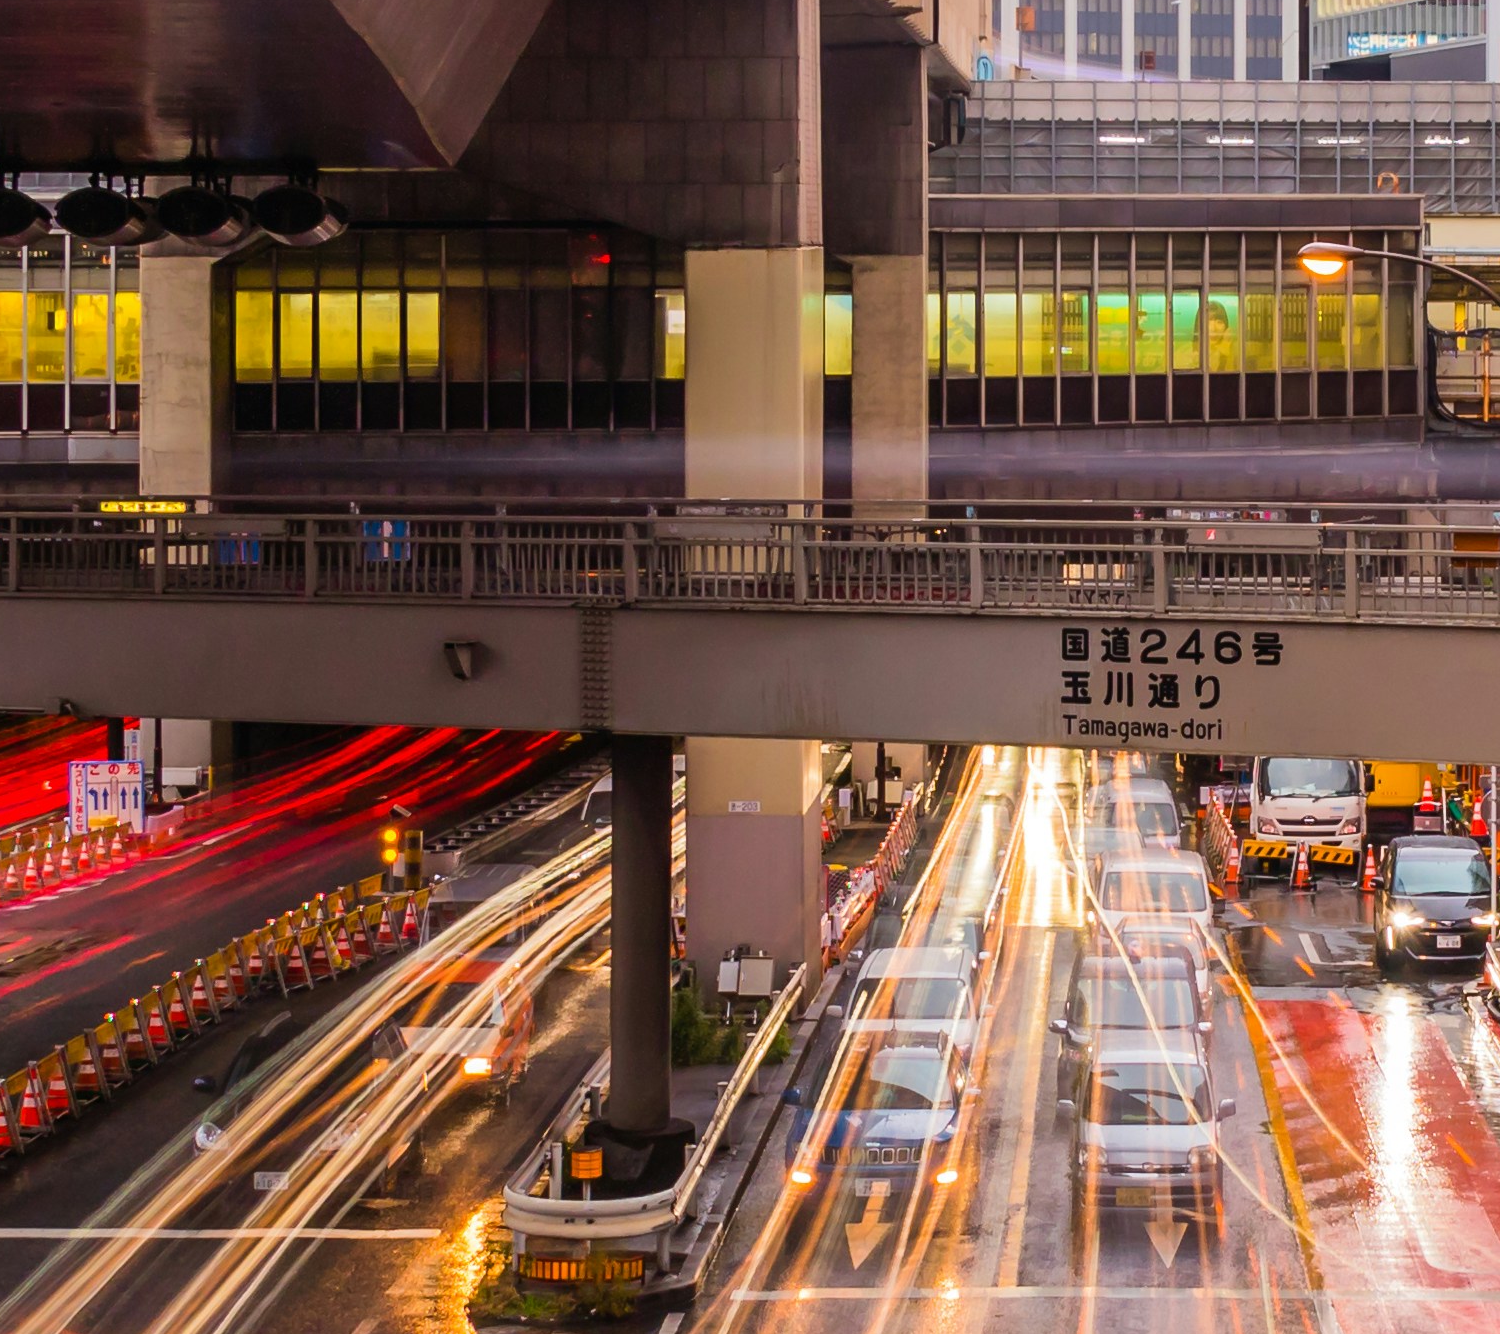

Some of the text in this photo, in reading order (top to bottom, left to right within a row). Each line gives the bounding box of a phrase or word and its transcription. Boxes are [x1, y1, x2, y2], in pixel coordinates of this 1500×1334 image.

[1061, 626, 1285, 666] 国道246号
[1060, 670, 1222, 710] 玉川通り
[1062, 714, 1223, 744] Tamagawa-dori
